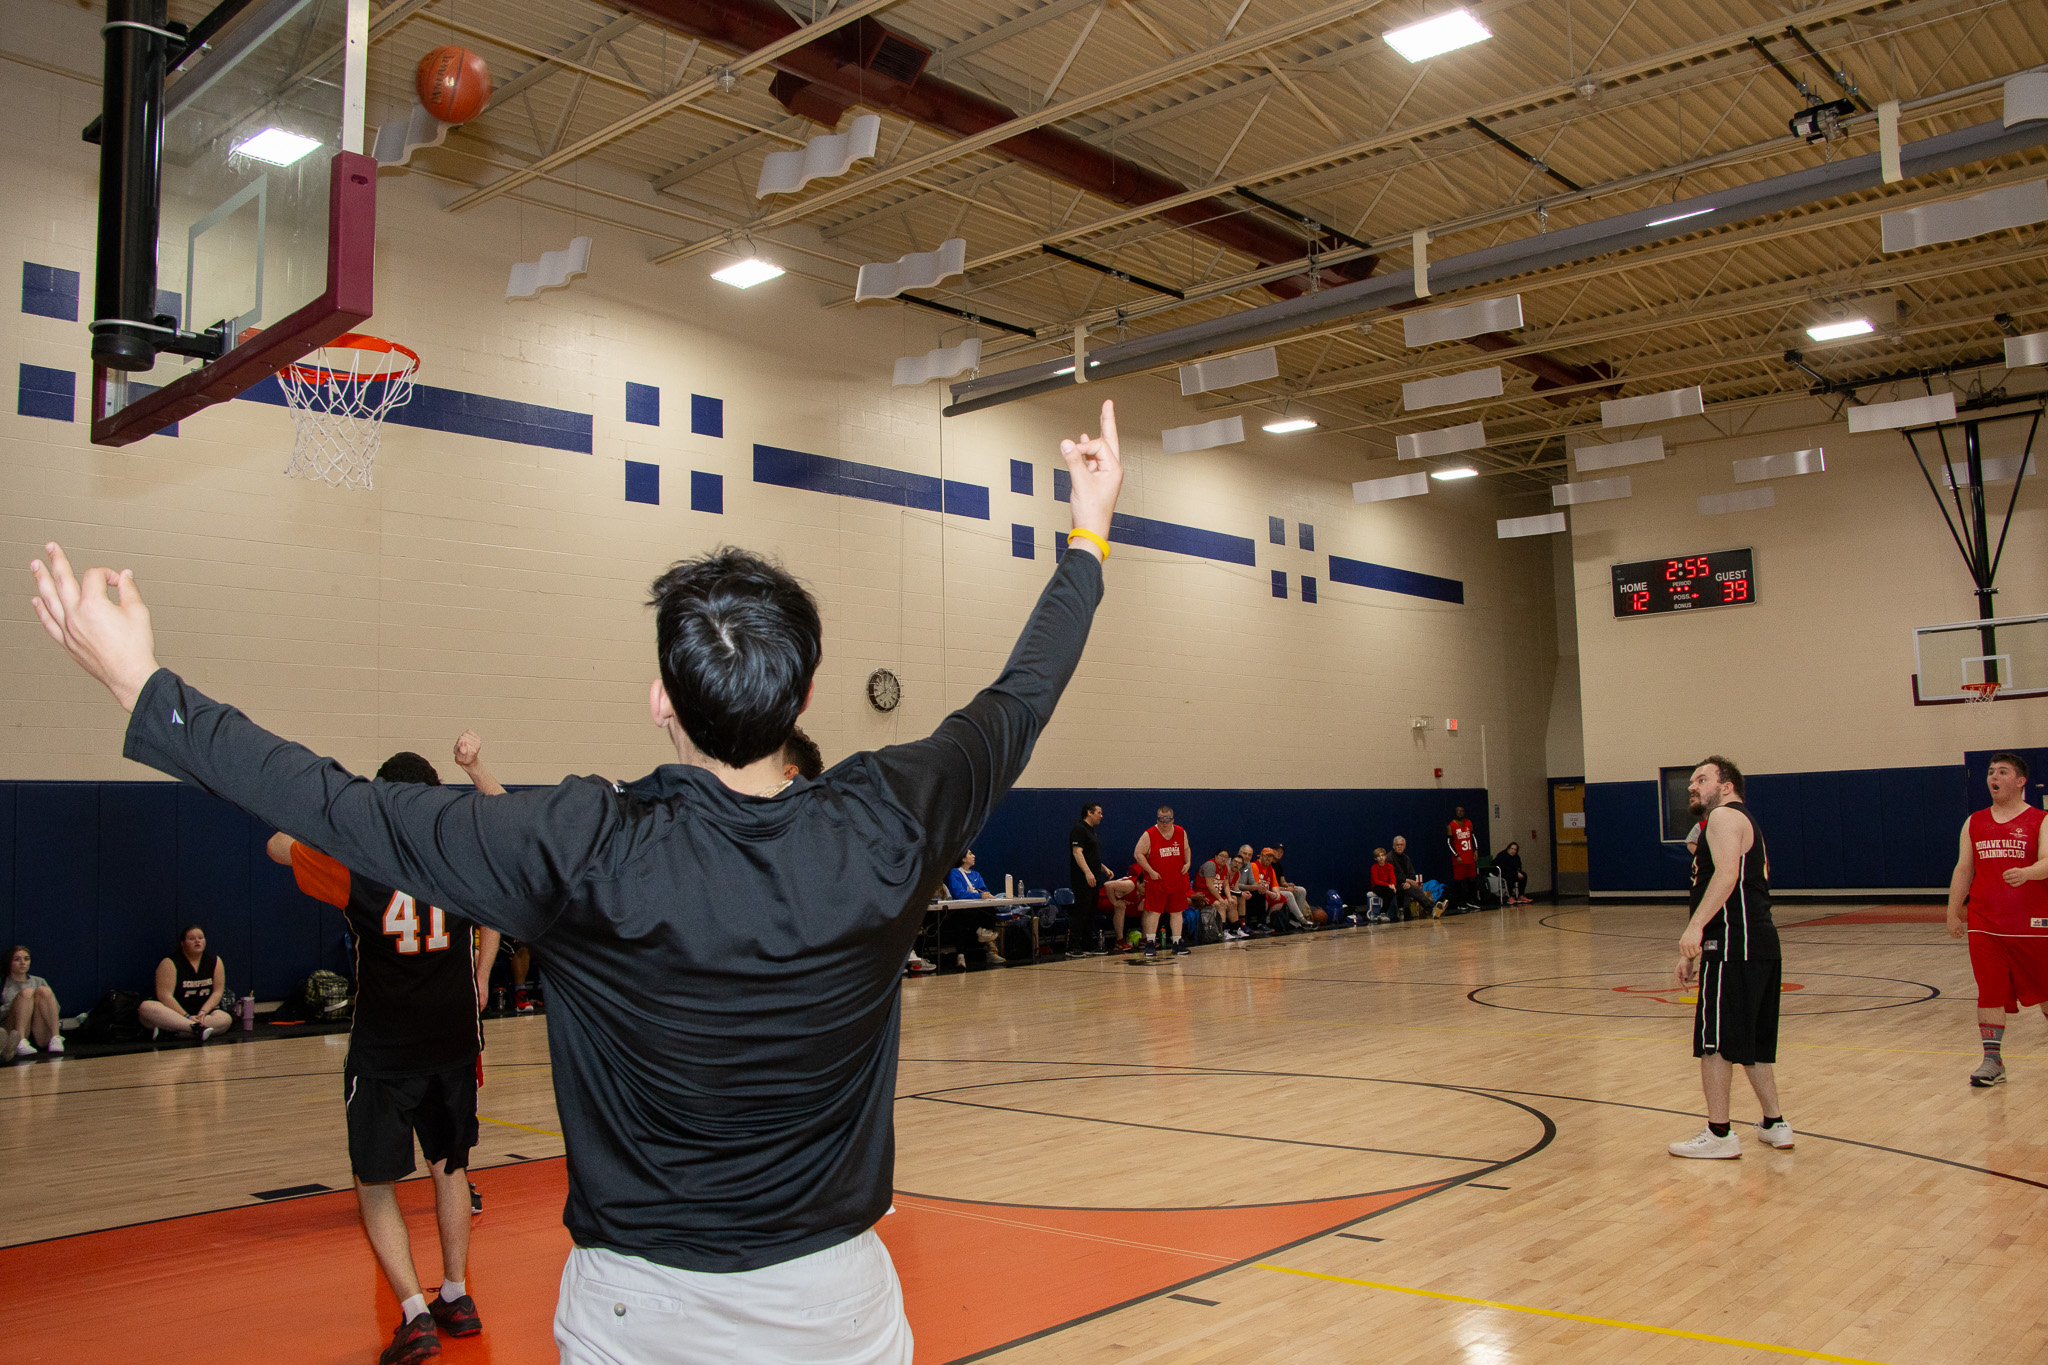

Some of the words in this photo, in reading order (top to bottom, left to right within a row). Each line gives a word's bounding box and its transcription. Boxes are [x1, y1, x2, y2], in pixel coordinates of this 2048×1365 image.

[1666, 556, 1709, 580] 2:55
[1715, 570, 1747, 582] GUEST
[1620, 582, 1648, 593] HOME
[1724, 580, 1747, 602] 39
[1633, 590, 1650, 611] 12
[1460, 840, 1471, 851] 31
[2002, 840, 2026, 850] VALLEY
[1978, 849, 2008, 859] TRAINING
[2008, 849, 2025, 858] CLUB
[382, 889, 450, 955] 41
